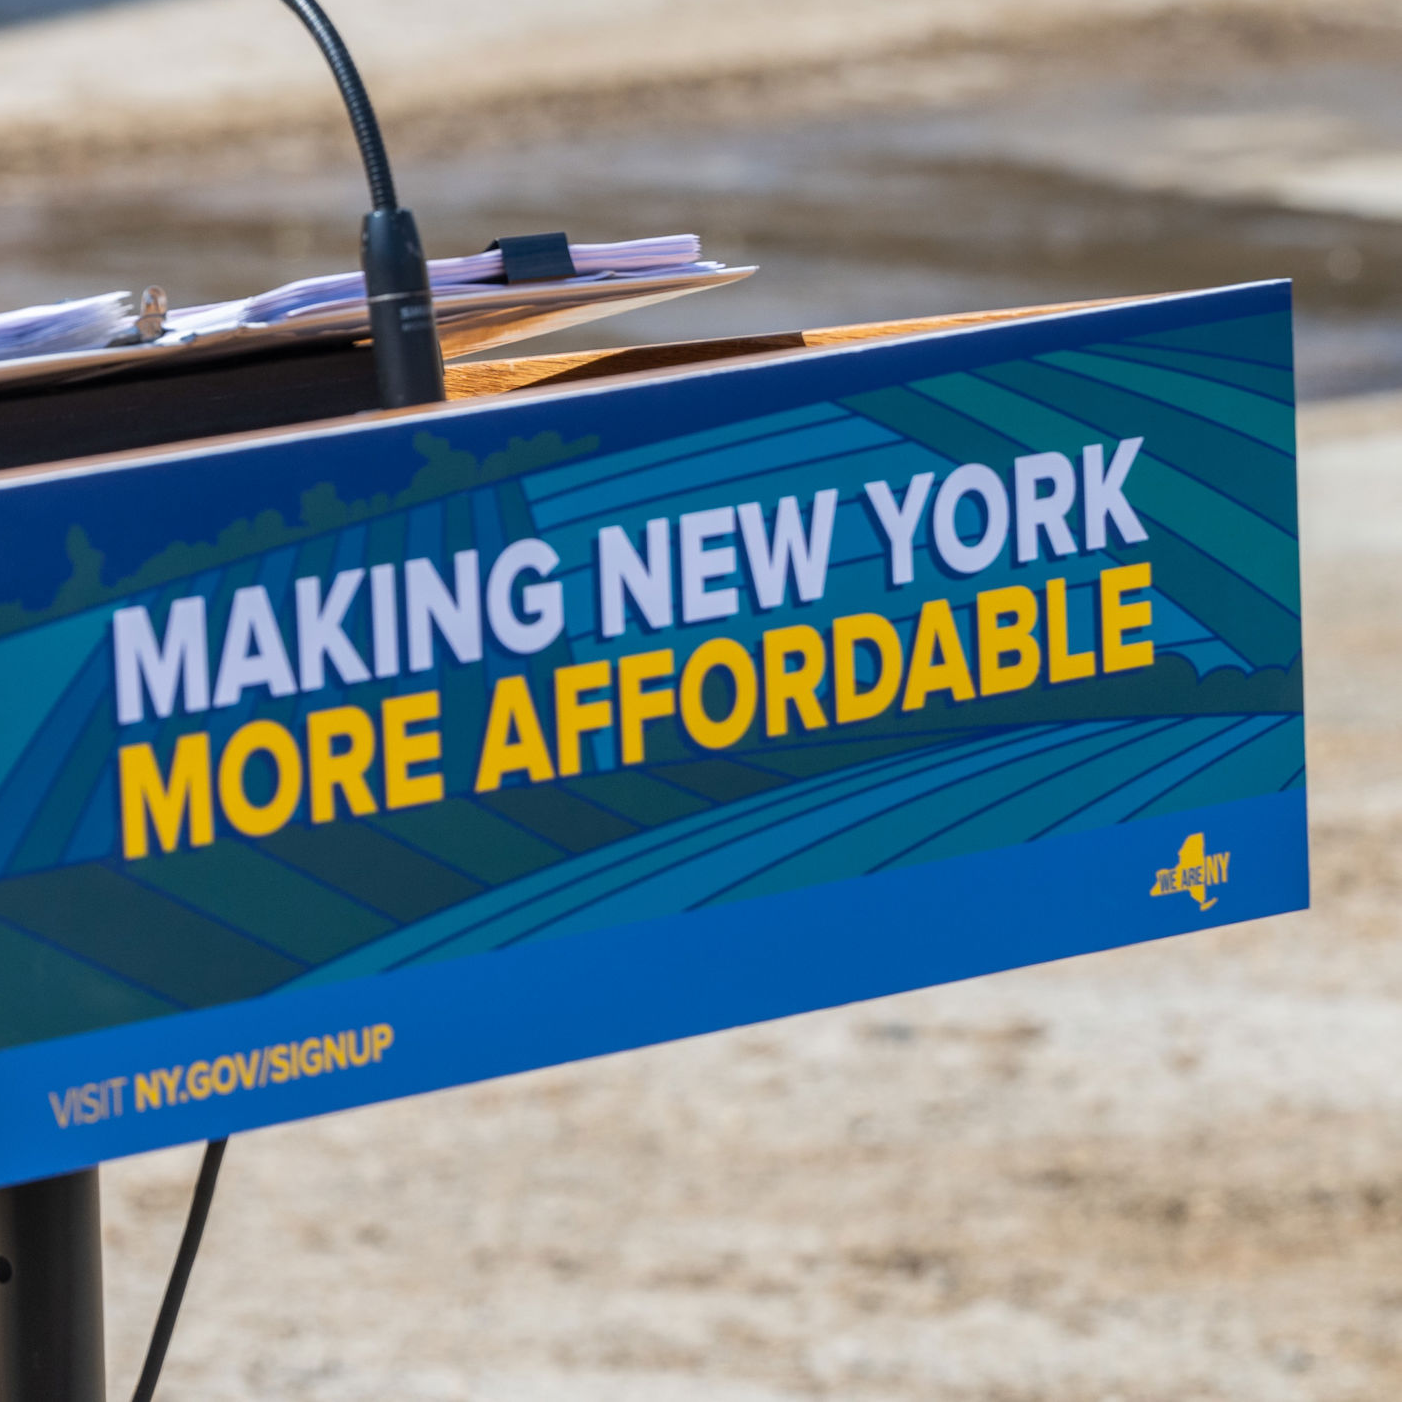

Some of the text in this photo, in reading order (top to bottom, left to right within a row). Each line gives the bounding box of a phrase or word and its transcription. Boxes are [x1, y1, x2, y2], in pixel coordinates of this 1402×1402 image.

[113, 436, 1149, 723] MAKING NEW YORK
[118, 561, 1156, 861] MORE AFFORDABLE
[1159, 851, 1230, 892] WE ARE NY
[48, 1023, 394, 1129] VISIT NY.GOV/SIGNUP
